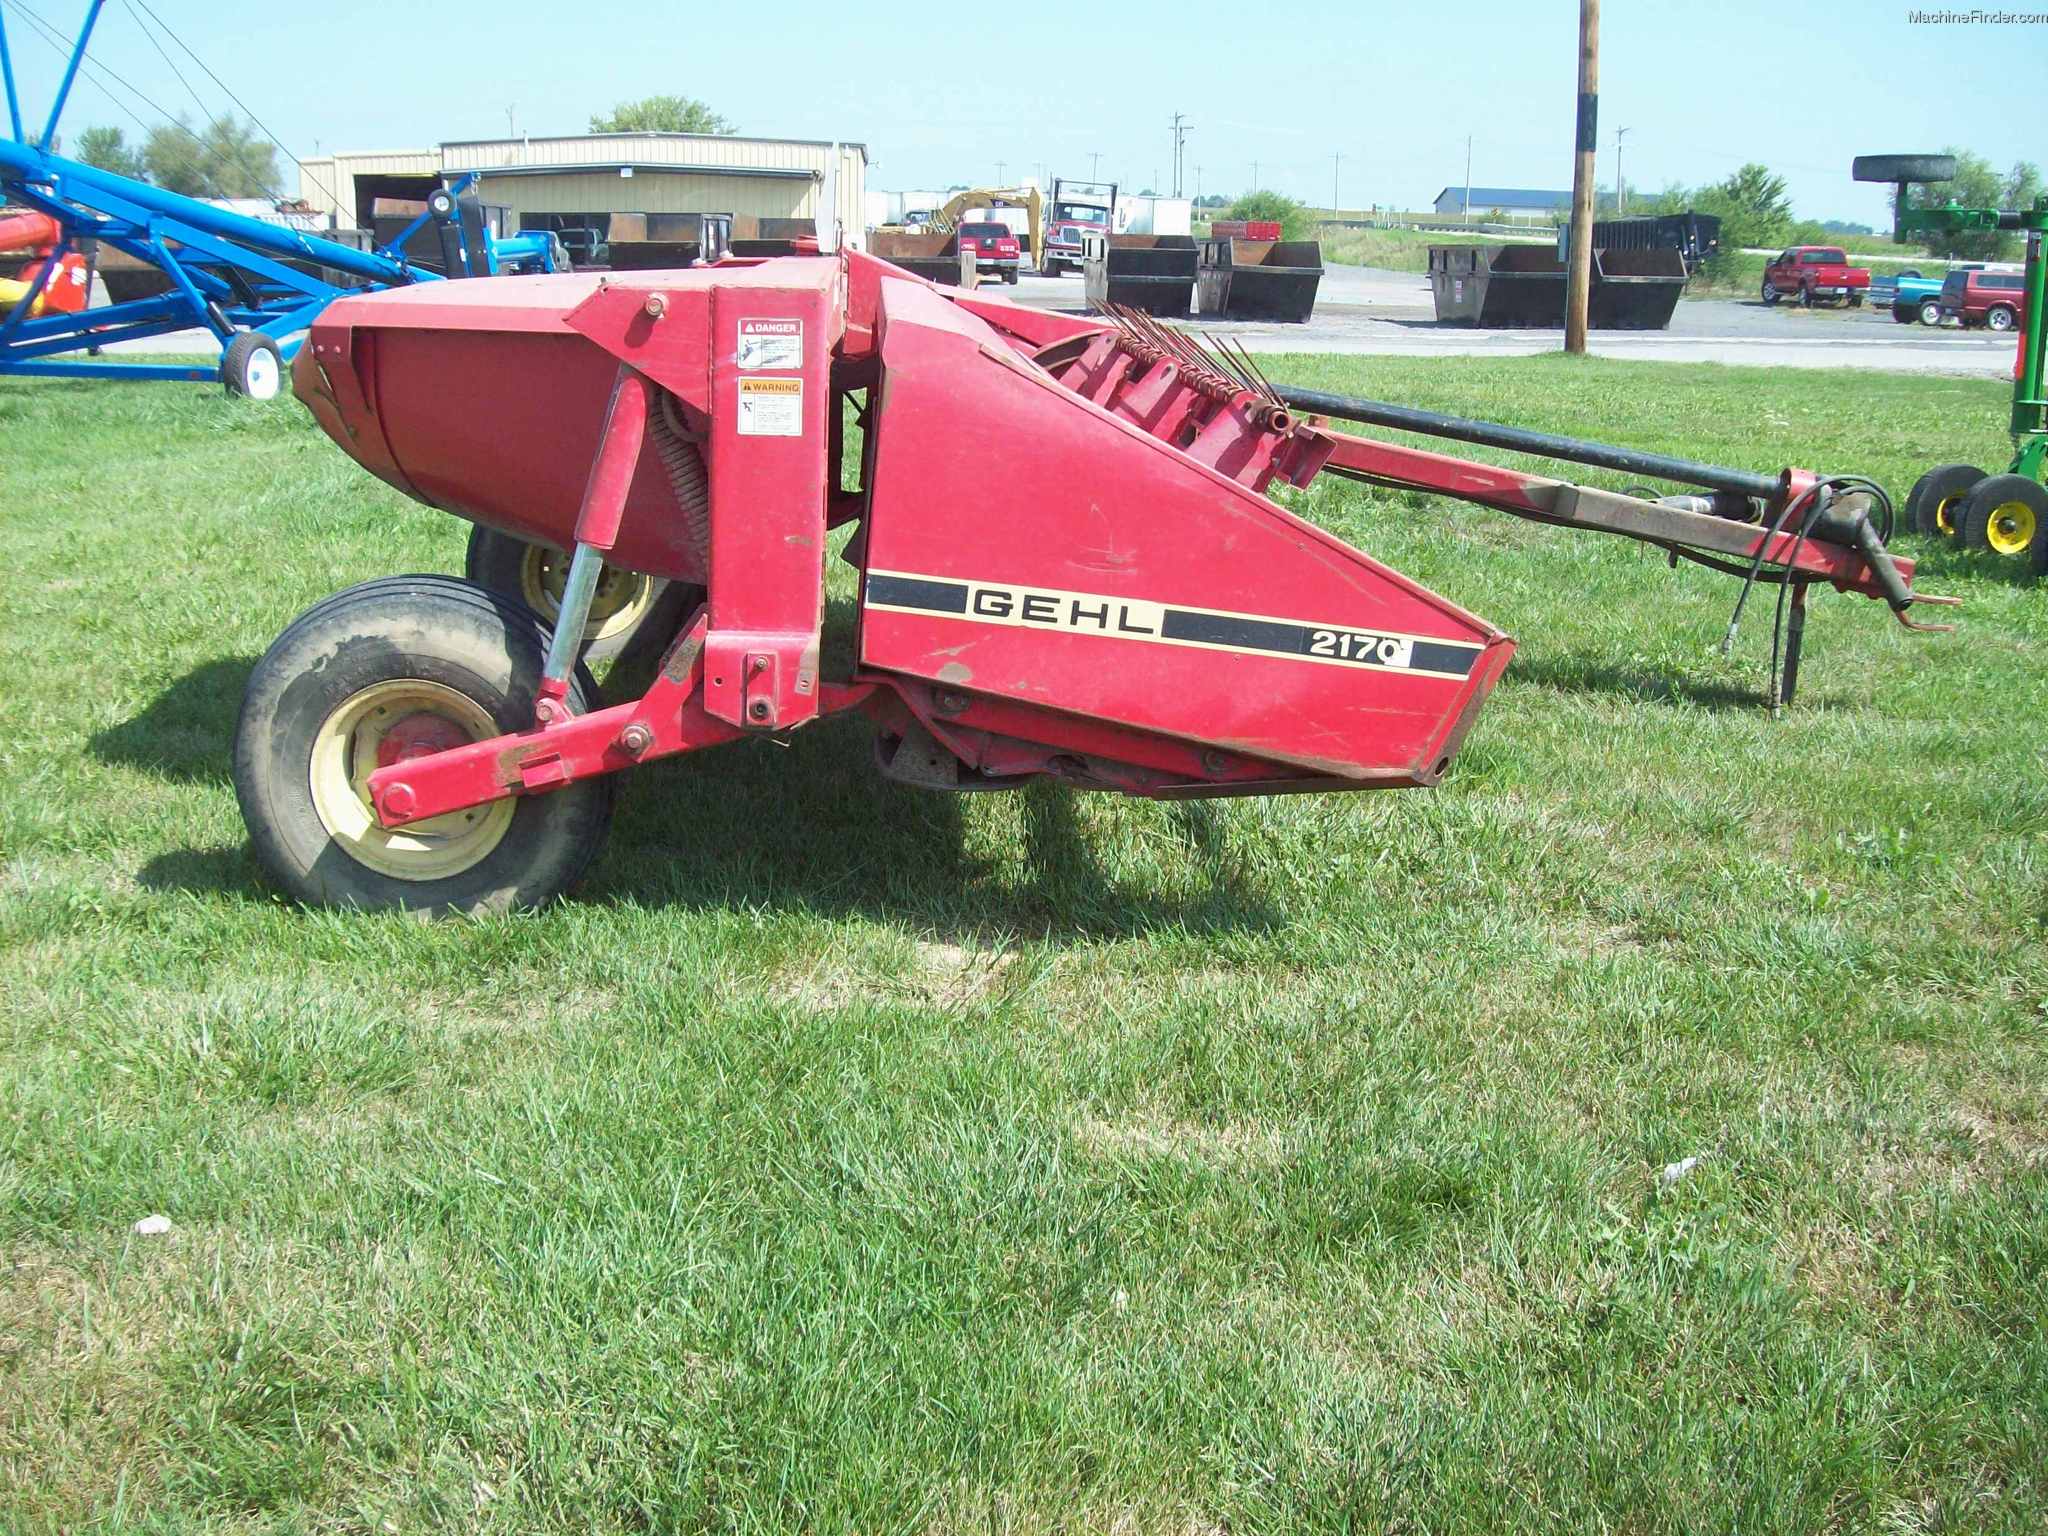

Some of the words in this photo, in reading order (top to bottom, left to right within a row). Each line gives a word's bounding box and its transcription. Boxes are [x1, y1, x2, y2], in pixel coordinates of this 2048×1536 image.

[755, 323, 796, 333] DANGER
[753, 383, 799, 392] WARNING
[973, 589, 1154, 634] GEHL
[1310, 630, 1400, 665] 2170
